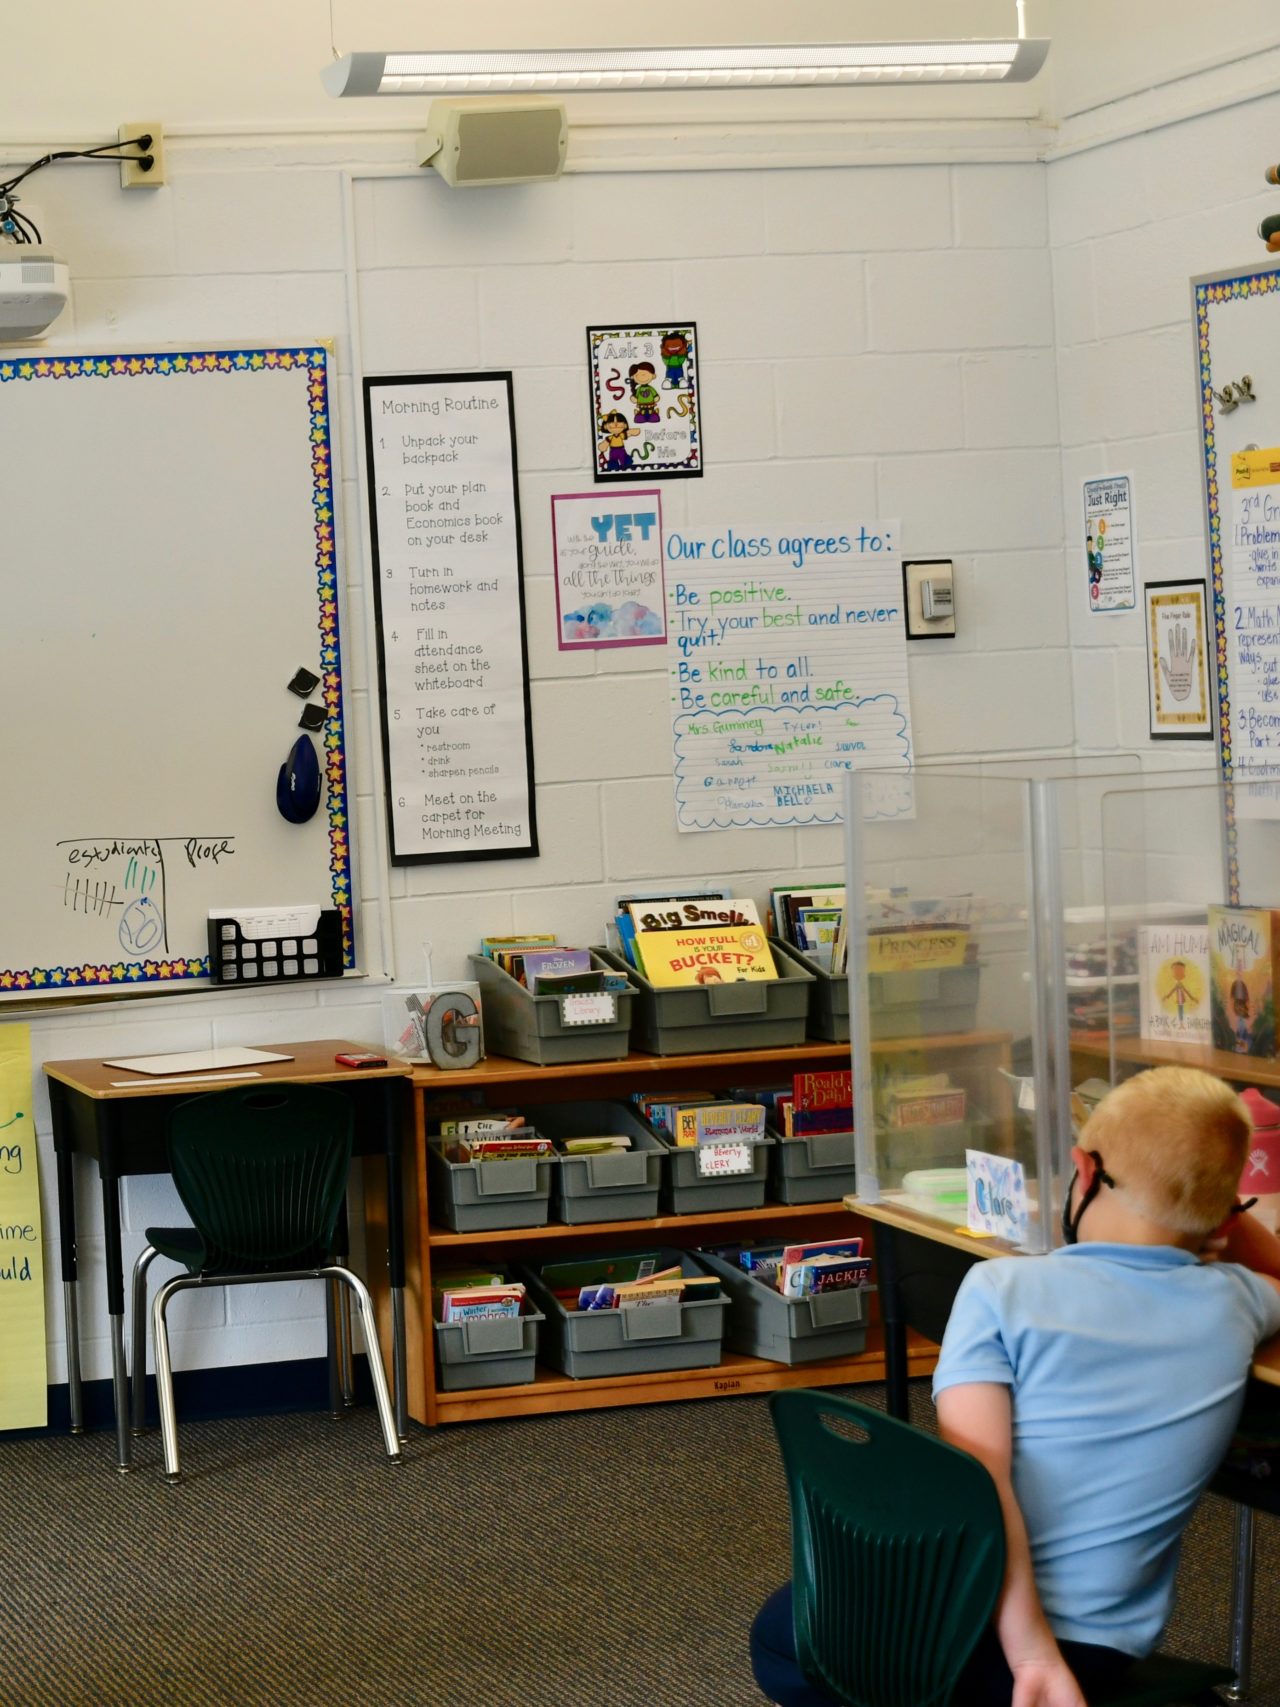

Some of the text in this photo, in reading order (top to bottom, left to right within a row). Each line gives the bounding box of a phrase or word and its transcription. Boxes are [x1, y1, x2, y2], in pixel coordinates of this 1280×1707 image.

[603, 342, 654, 360] Ask 3
[382, 397, 500, 416] Morning Routine
[402, 434, 479, 450] Unpack your
[644, 428, 688, 442] Before
[403, 451, 459, 466] backpack
[656, 445, 677, 459] Me
[405, 481, 487, 498] Put your plan
[405, 499, 460, 513] book and
[1087, 490, 1127, 507] Just Right
[406, 513, 504, 529] Economics book
[591, 512, 656, 542] YET
[407, 530, 489, 548] on your desk
[666, 526, 892, 568] Our class agrees to:
[408, 567, 454, 579] Turn in
[563, 569, 658, 588] all the things
[410, 579, 499, 596] homework and
[411, 600, 446, 612] notes
[675, 581, 792, 616] Be positive.
[675, 604, 898, 640] Try your best and never
[1248, 606, 1274, 630] Math
[416, 628, 448, 641] Fill in
[678, 629, 721, 657] quit.
[414, 643, 484, 657] attendance
[414, 658, 491, 674] sheet on the
[678, 662, 703, 683] Be
[708, 657, 748, 682] kind
[756, 657, 778, 680] to
[414, 676, 484, 691] whiteboard
[680, 687, 707, 710] Be
[710, 683, 775, 708] careful
[780, 684, 810, 703] and
[416, 703, 496, 720] Take care of
[417, 725, 440, 739] you
[1249, 730, 1271, 748] Part
[426, 741, 471, 752] restroom
[428, 756, 451, 766] drink
[428, 765, 499, 778] sharpen pencils
[773, 783, 834, 796] MICHAELA
[424, 790, 498, 807] Meet on the
[421, 808, 486, 824] carpet for
[421, 823, 522, 840] Morning Meeting
[640, 911, 682, 929] Big
[676, 935, 738, 947] HOW FULL
[744, 936, 759, 948] #1
[1217, 923, 1259, 955] MAGICAL
[541, 959, 575, 971] FROZEN
[669, 952, 755, 972] BUCKET?
[737, 965, 766, 974] For Kids
[426, 992, 480, 1070] G
[804, 1073, 845, 1094] Roald
[812, 1087, 847, 1107] Dahl
[740, 1124, 759, 1135] World
[975, 1176, 1018, 1225] Clare
[817, 1268, 869, 1285] JACKIE
[463, 1305, 488, 1316] Winter
[714, 1378, 741, 1393] Kaplan
